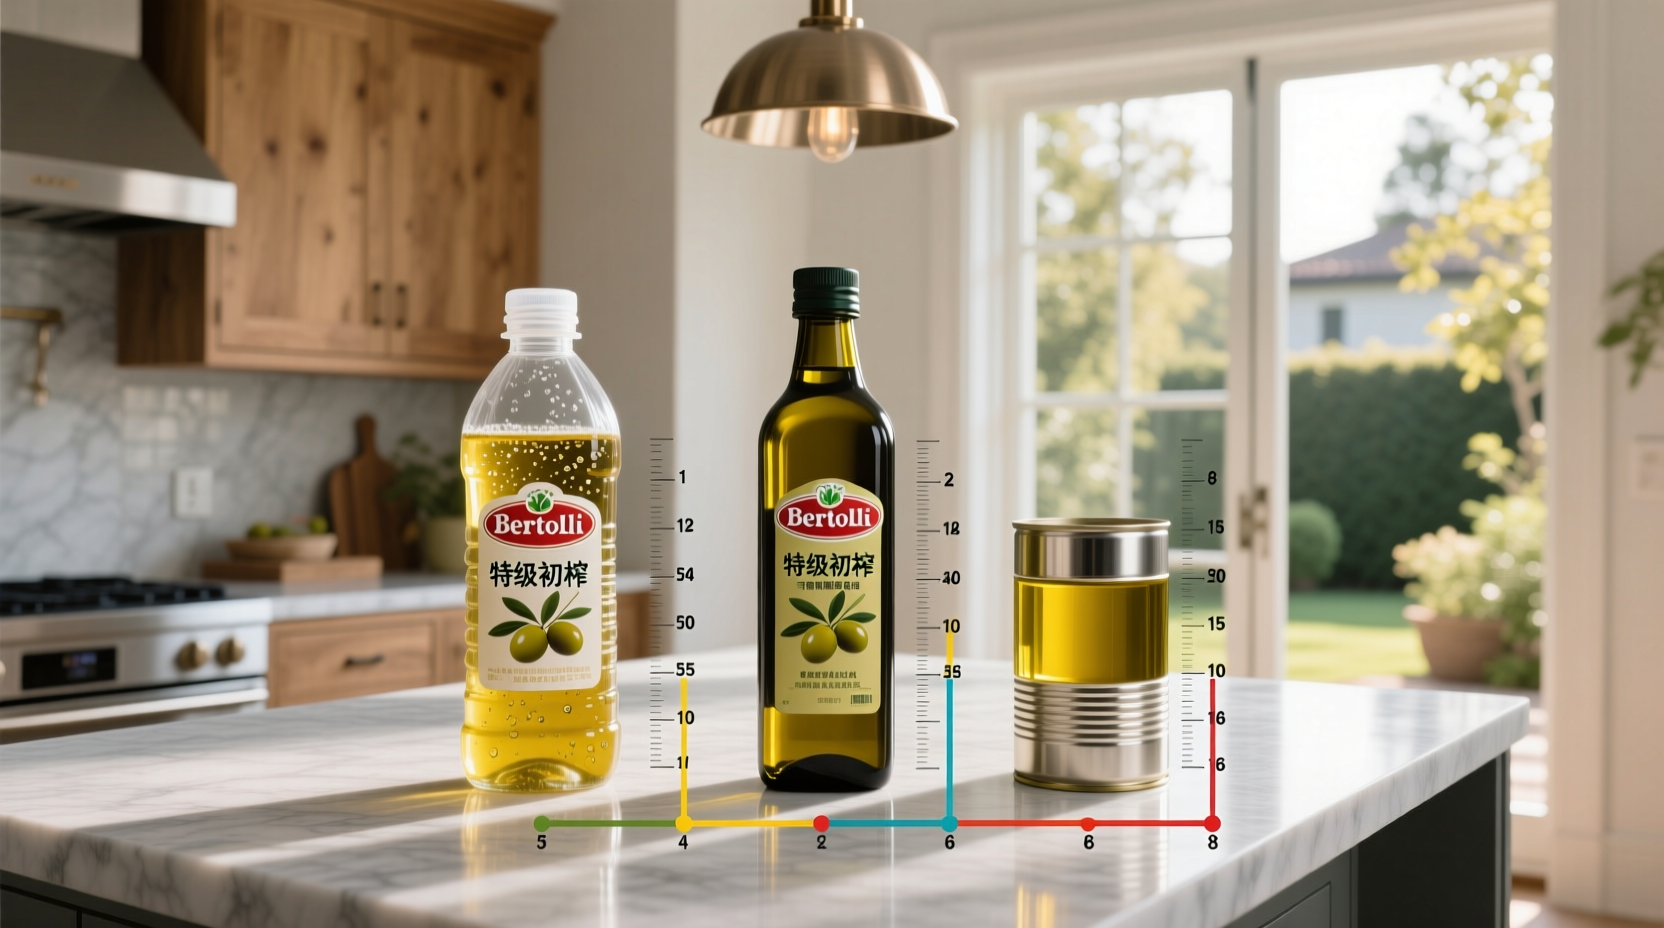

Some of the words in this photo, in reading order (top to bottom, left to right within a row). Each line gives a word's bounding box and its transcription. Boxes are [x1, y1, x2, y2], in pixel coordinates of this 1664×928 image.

[494, 513, 584, 535] Bertolli
[787, 507, 871, 527] Bertolli
[490, 560, 588, 588] 特级初榨
[783, 552, 875, 577] 特级初榨
